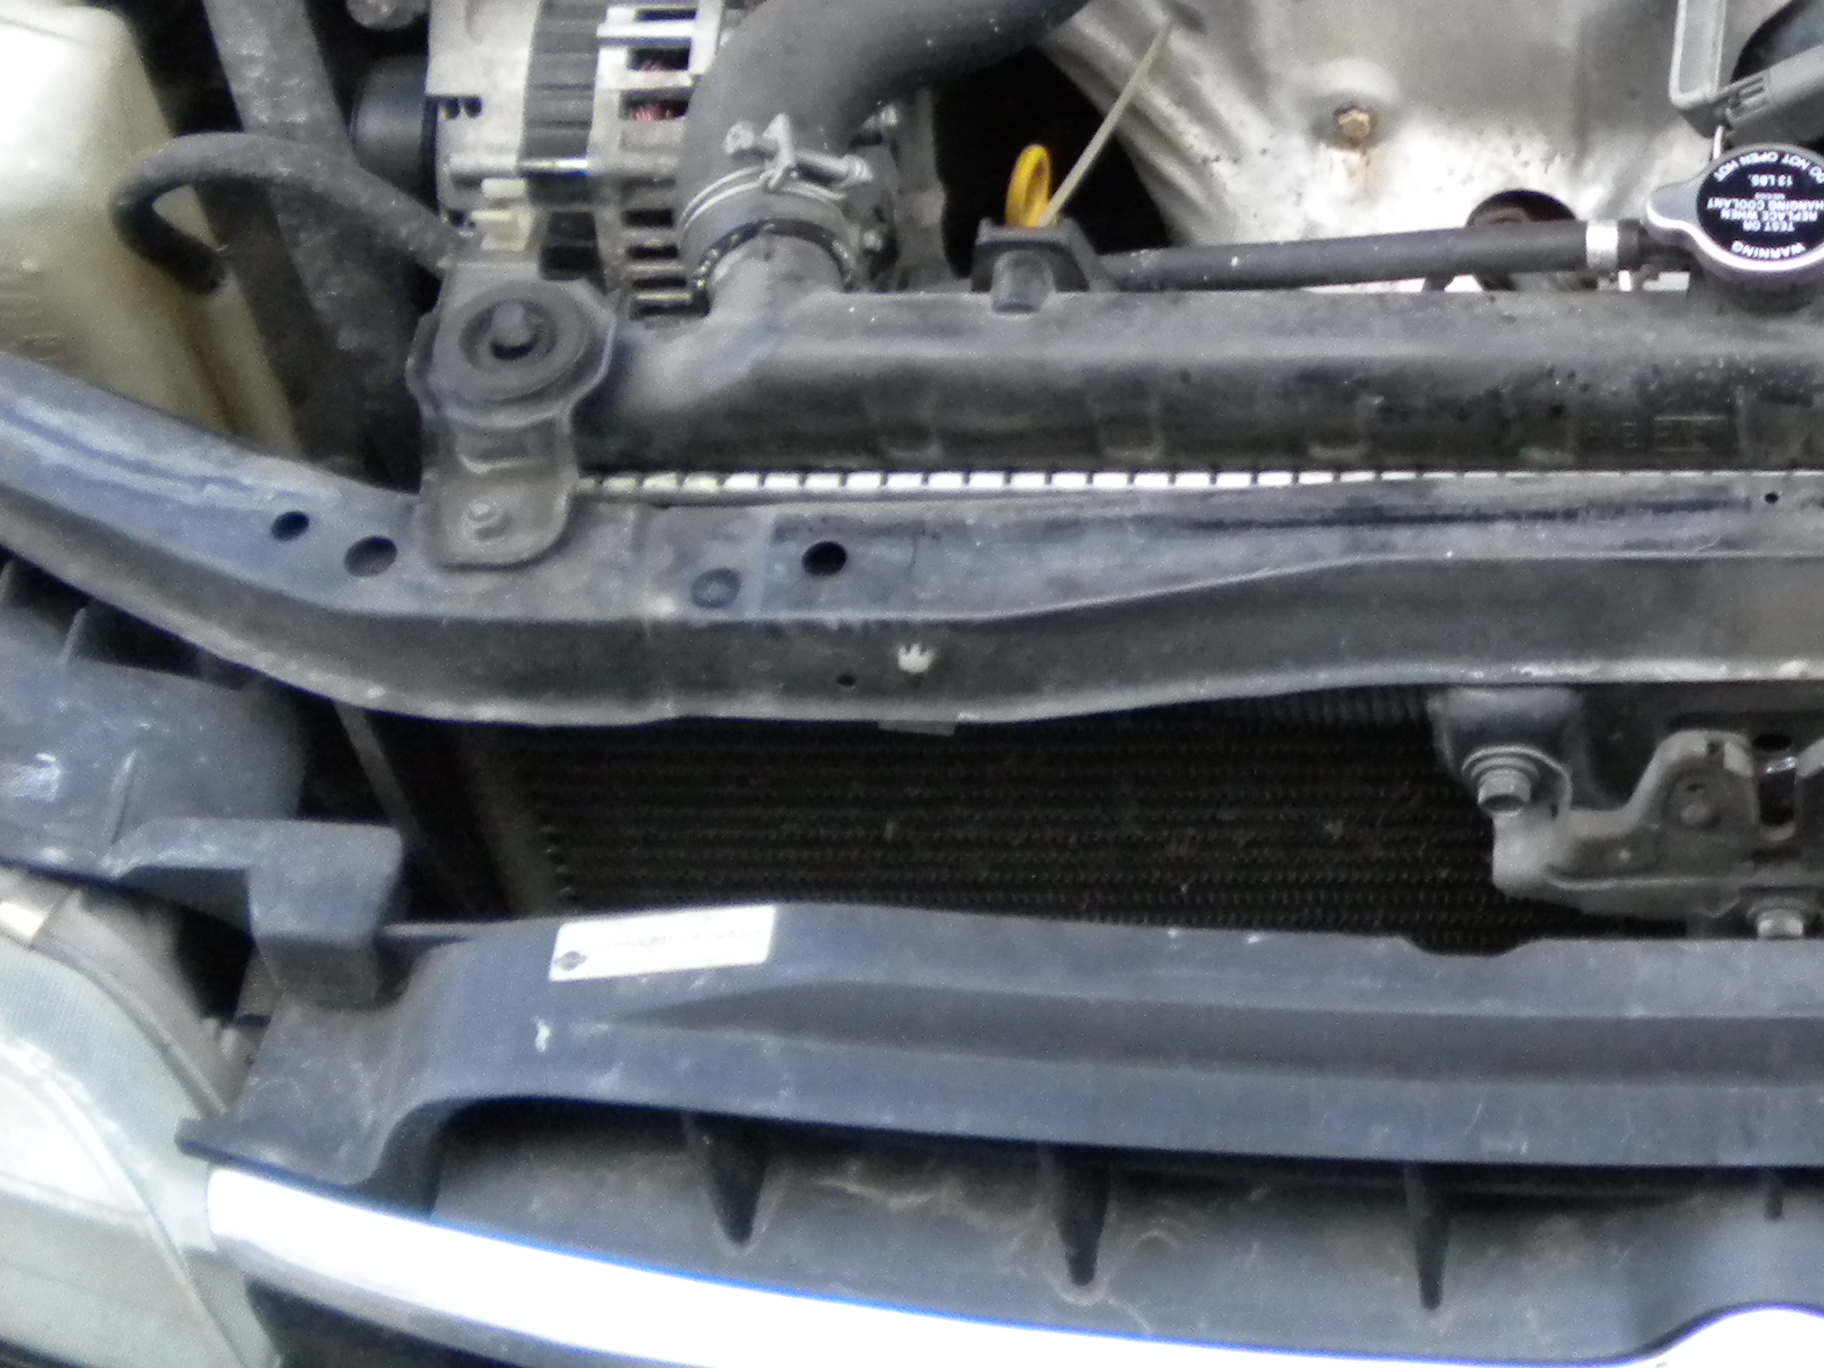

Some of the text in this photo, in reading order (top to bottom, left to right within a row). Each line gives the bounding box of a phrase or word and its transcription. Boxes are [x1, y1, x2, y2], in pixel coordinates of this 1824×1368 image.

[1739, 152, 1778, 165] OPEN
[1781, 153, 1810, 171] NOT
[1714, 160, 1739, 182] HOT
[1707, 198, 1765, 210] COOLANT
[1721, 208, 1818, 222] REPLACE WHEN
[1743, 220, 1795, 232] TEST OR
[1731, 240, 1806, 259] WARNING
